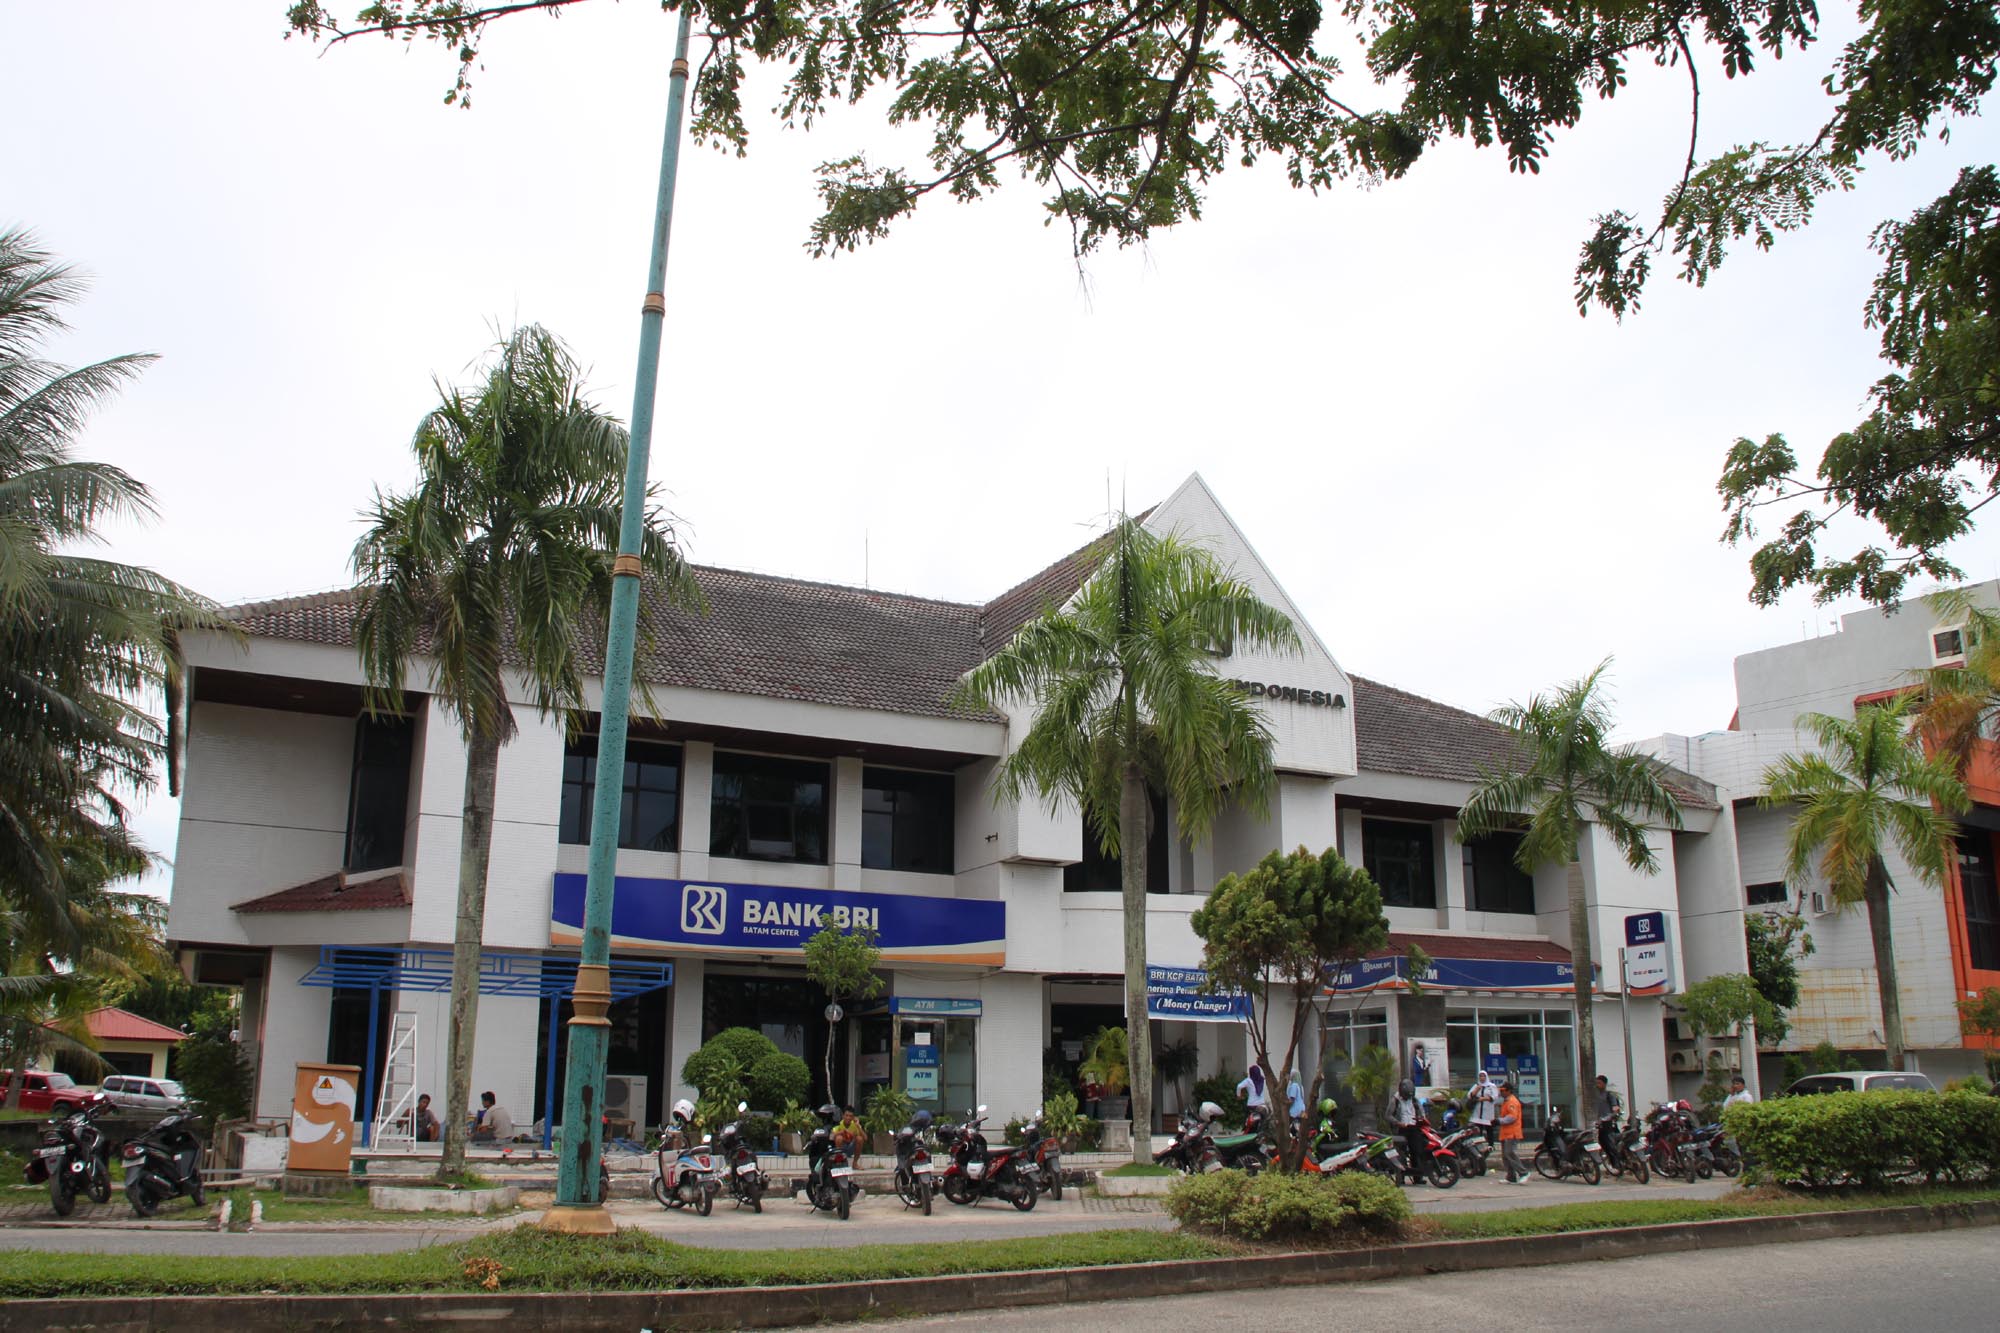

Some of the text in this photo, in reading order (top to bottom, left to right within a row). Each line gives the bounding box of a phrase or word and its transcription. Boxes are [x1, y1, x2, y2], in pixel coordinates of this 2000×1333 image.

[743, 899, 879, 931] BANK BRI
[743, 927, 799, 937] BATAM CENTER
[1638, 951, 1656, 959] ATM
[1151, 970, 1165, 979] BRI
[1167, 972, 1183, 981] KCP
[914, 1001, 935, 1009] ATM
[1162, 998, 1192, 1011] Money
[1193, 1000, 1227, 1012] Changer
